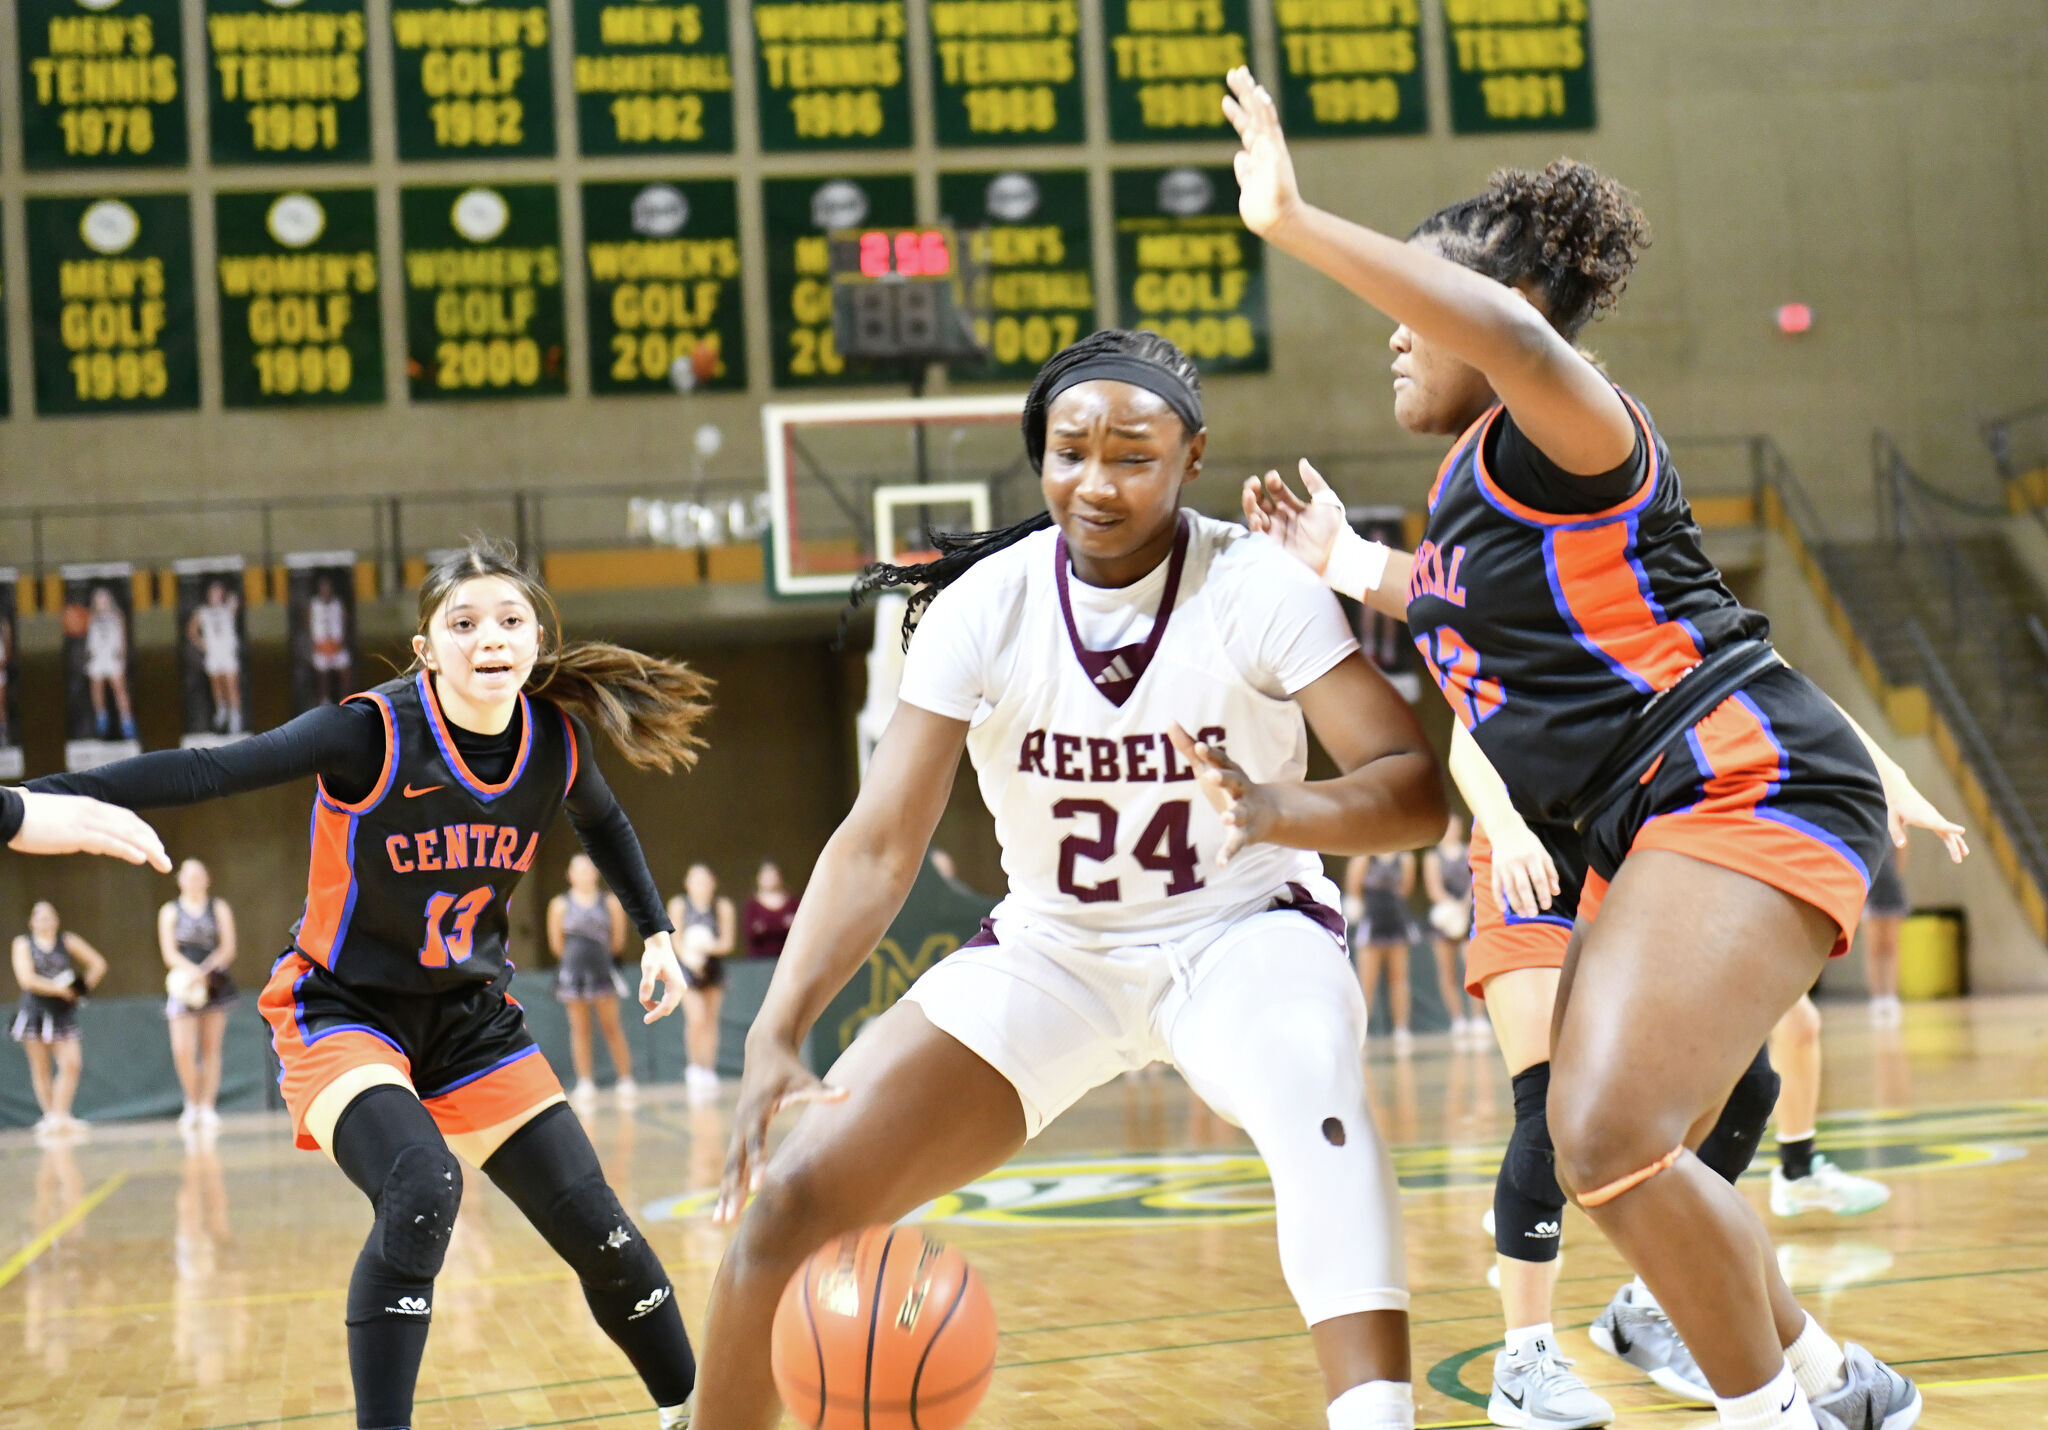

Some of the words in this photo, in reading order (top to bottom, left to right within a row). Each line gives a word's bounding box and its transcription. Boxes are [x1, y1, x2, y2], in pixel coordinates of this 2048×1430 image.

[49, 15, 153, 53] MEN'S
[208, 12, 368, 52] WOMEN'S
[392, 8, 549, 48] WOMEN'S
[601, 5, 701, 44] MEN'S
[753, 1, 908, 39] WOMEN'S
[764, 41, 901, 89] TENNIS
[939, 38, 1074, 85] TENNIS
[1112, 33, 1246, 80] TENNIS
[1284, 29, 1415, 76] TENNIS
[1453, 26, 1584, 72] TENNIS
[32, 54, 176, 104] TENNIS
[218, 53, 360, 101] TENNIS
[422, 49, 522, 98] GOLF
[406, 248, 560, 289] WOMEN'S
[589, 239, 742, 281] WOMEN'S
[1137, 232, 1241, 268] MEN'S
[60, 258, 164, 298] MEN'S
[217, 253, 378, 296] WOMEN'S
[1134, 269, 1247, 313] GOLF
[61, 299, 164, 350] GOLF
[249, 297, 349, 344] GOLF
[436, 290, 533, 336] GOLF
[613, 282, 718, 330] GOLF
[72, 351, 167, 399] 1995
[256, 346, 351, 393] 1999
[437, 338, 539, 388] 2000
[385, 823, 540, 873] CENTRA
[1052, 798, 1206, 903] 24
[419, 884, 495, 969] 13
